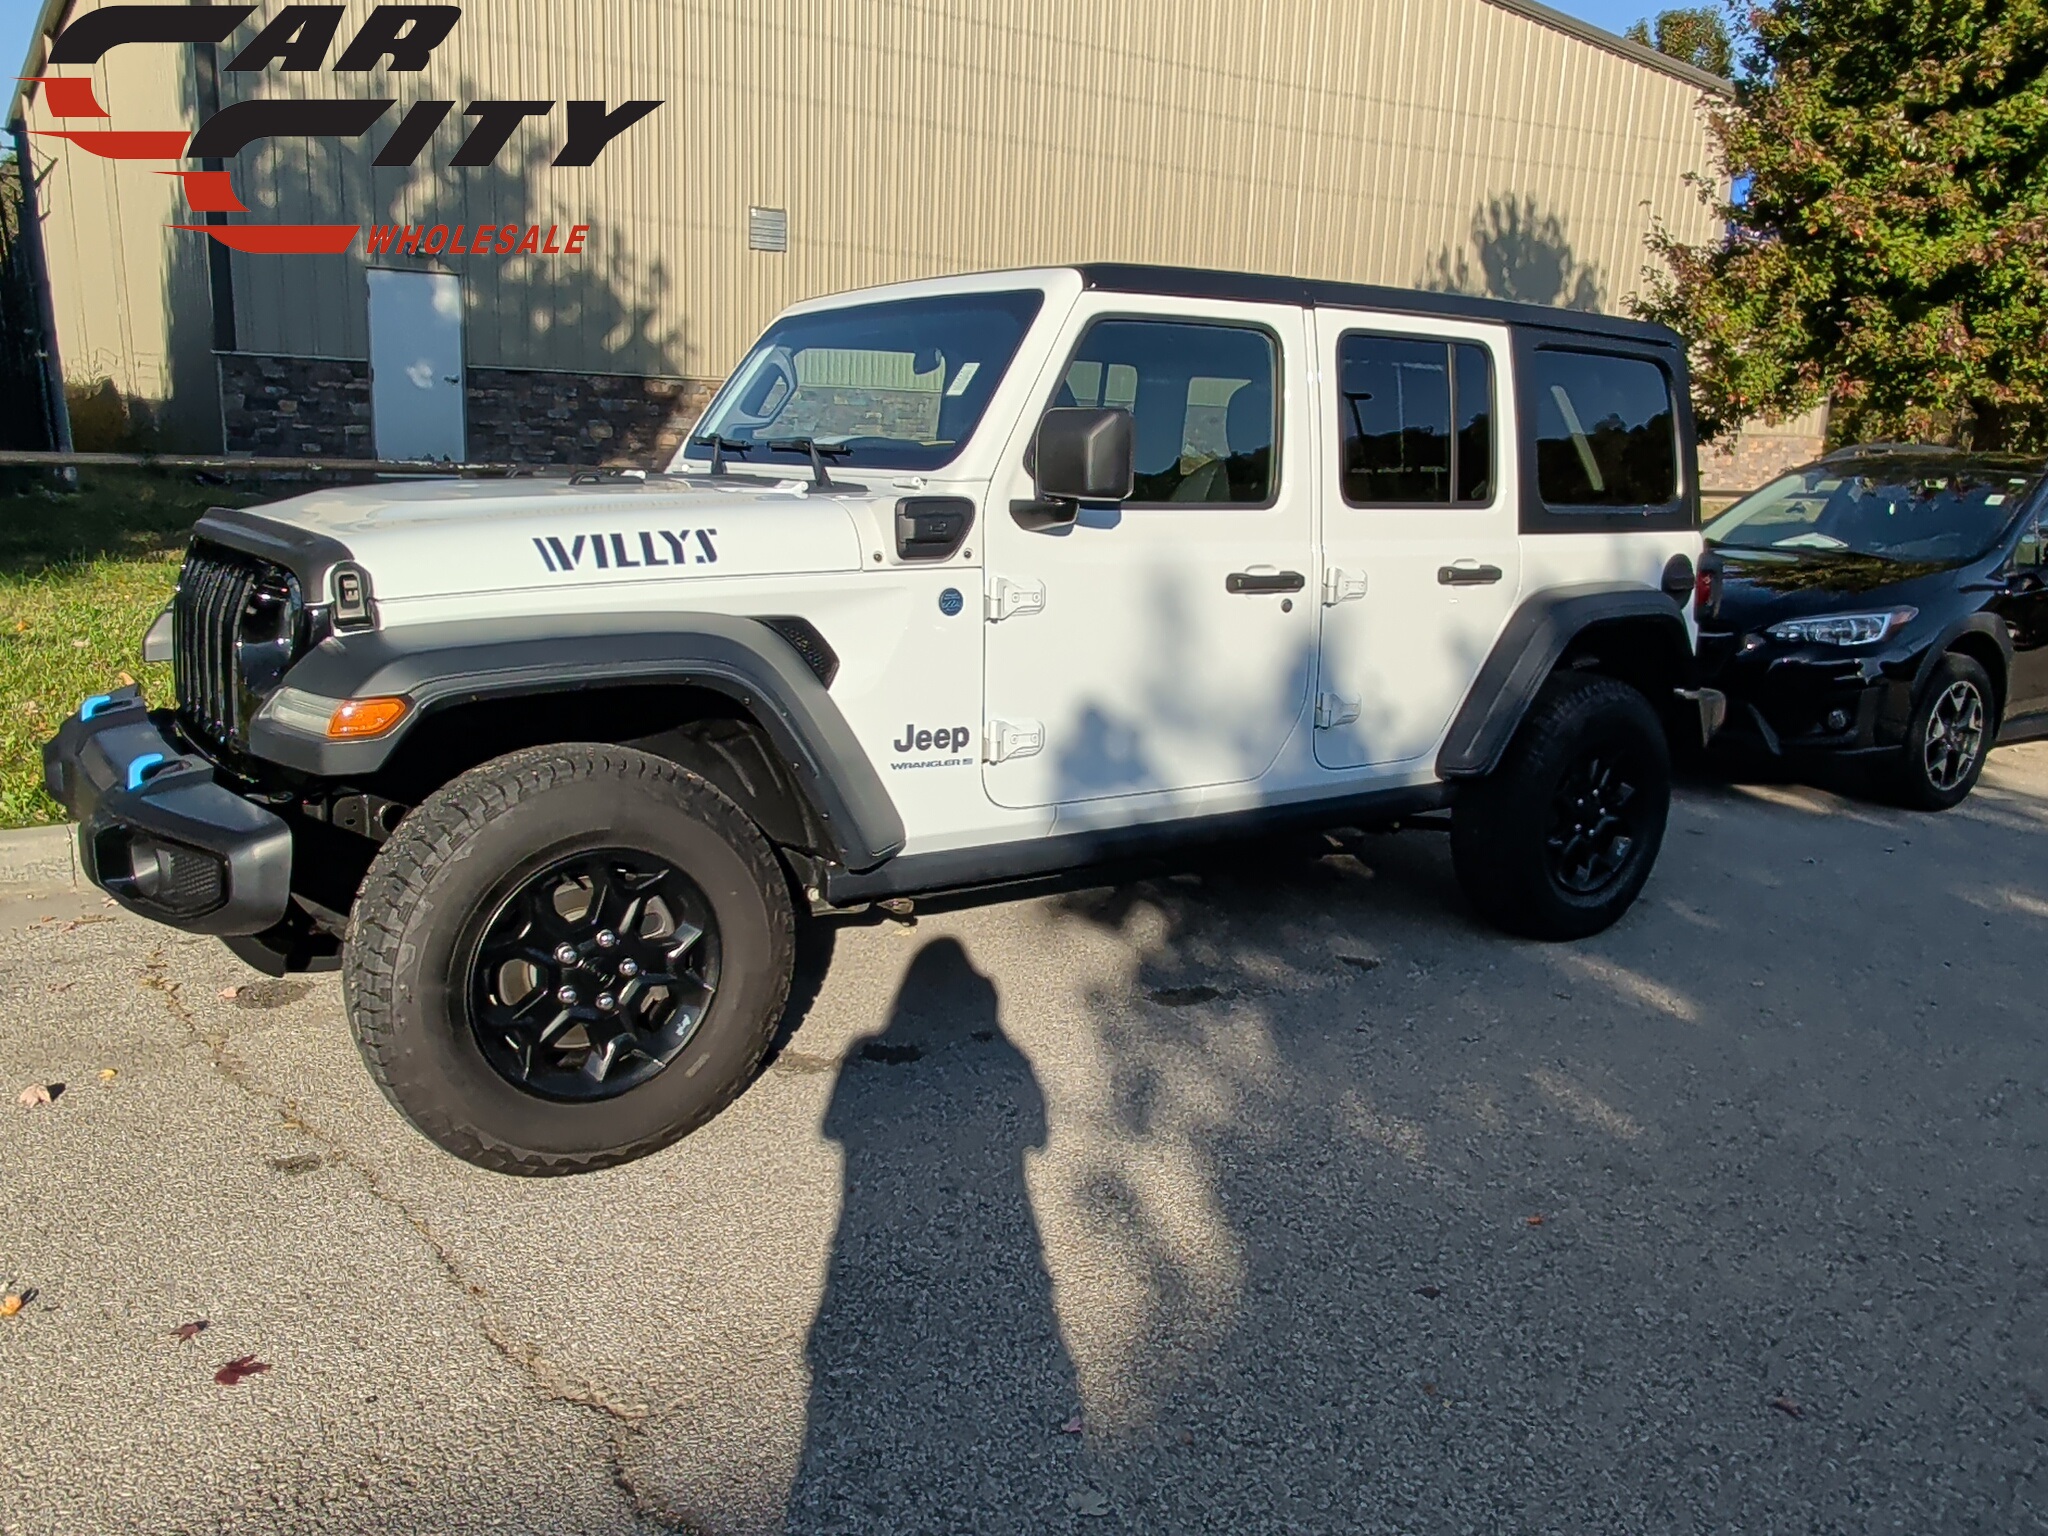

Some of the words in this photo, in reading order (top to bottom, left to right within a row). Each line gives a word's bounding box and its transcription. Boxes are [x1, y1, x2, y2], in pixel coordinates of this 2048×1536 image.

[532, 528, 718, 572] WILLYS
[893, 724, 970, 753] Jeep
[890, 758, 961, 770] WRANGLER
